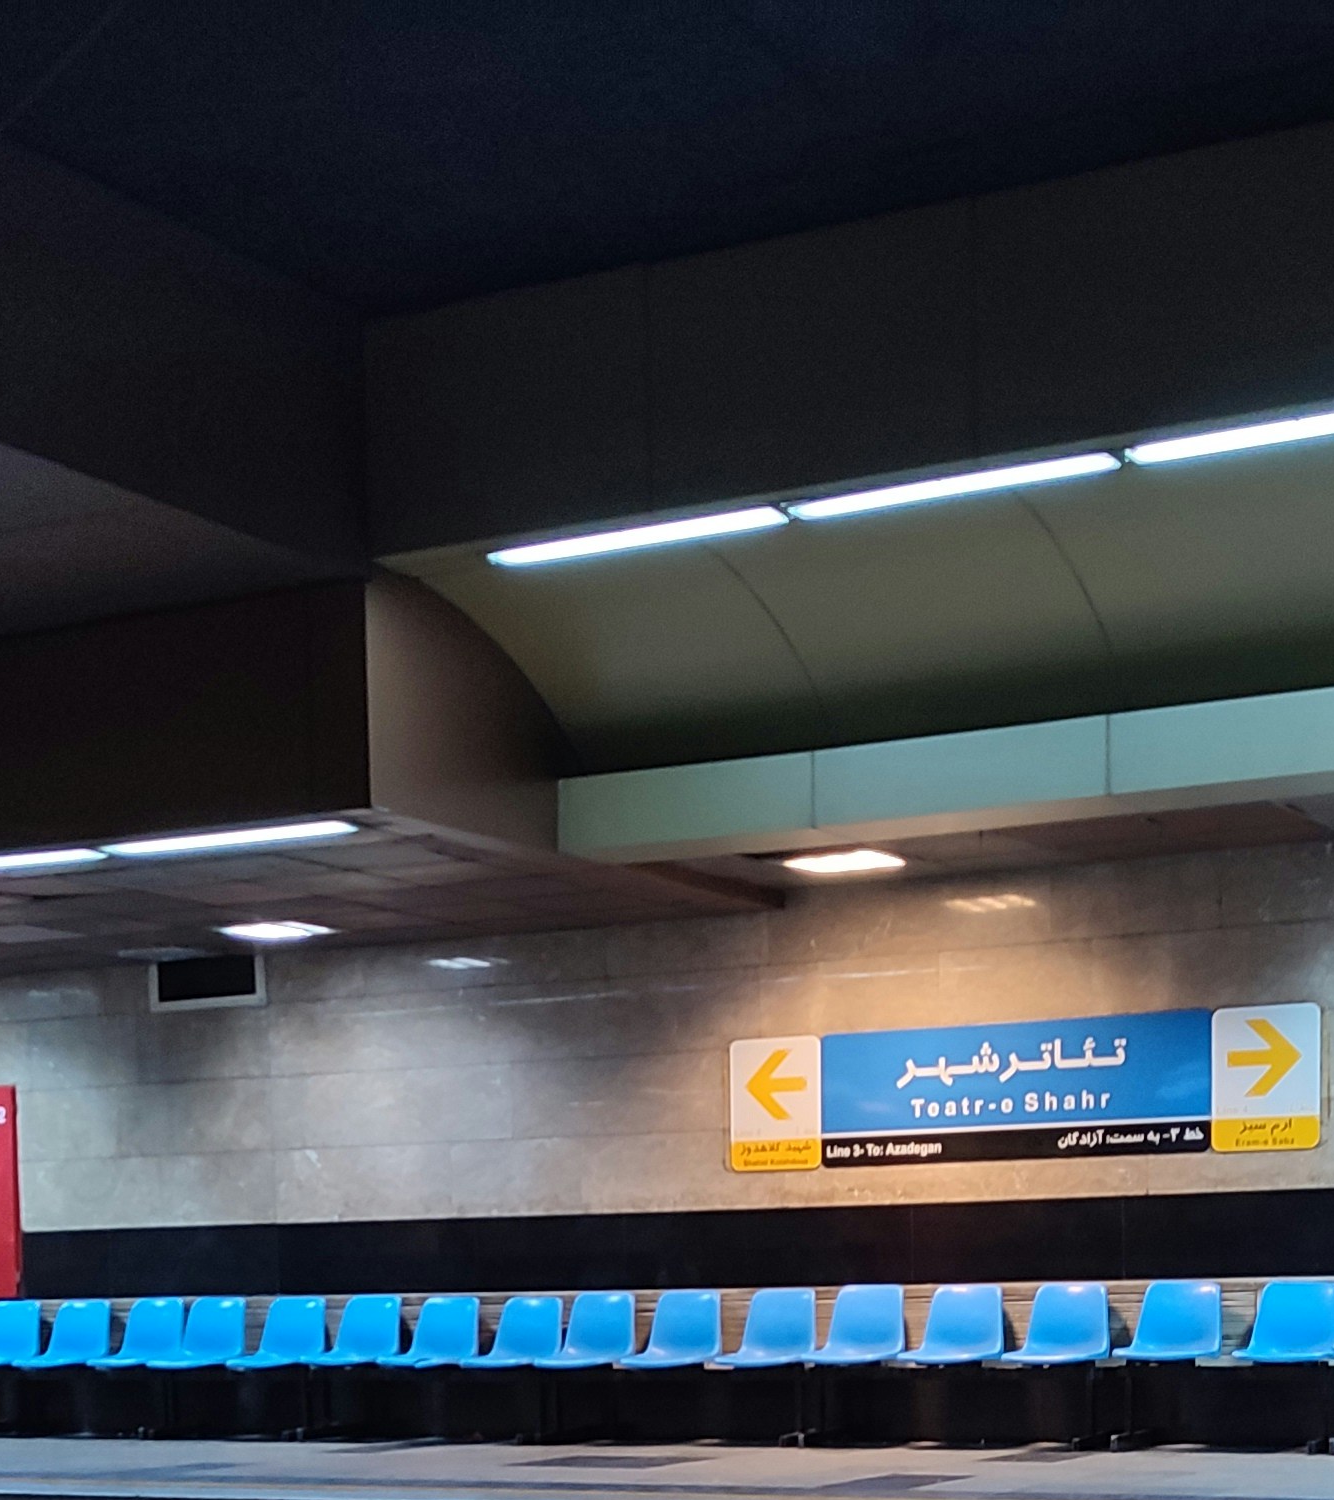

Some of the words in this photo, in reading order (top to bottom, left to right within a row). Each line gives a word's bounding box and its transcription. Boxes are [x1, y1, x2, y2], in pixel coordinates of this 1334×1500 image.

[1024, 1089, 1110, 1113] Shahr
[1057, 1128, 1105, 1149] آزادگان
[1183, 1126, 1205, 1142] خط
[825, 1144, 851, 1159] Line
[886, 1141, 943, 1158] Azadegan
